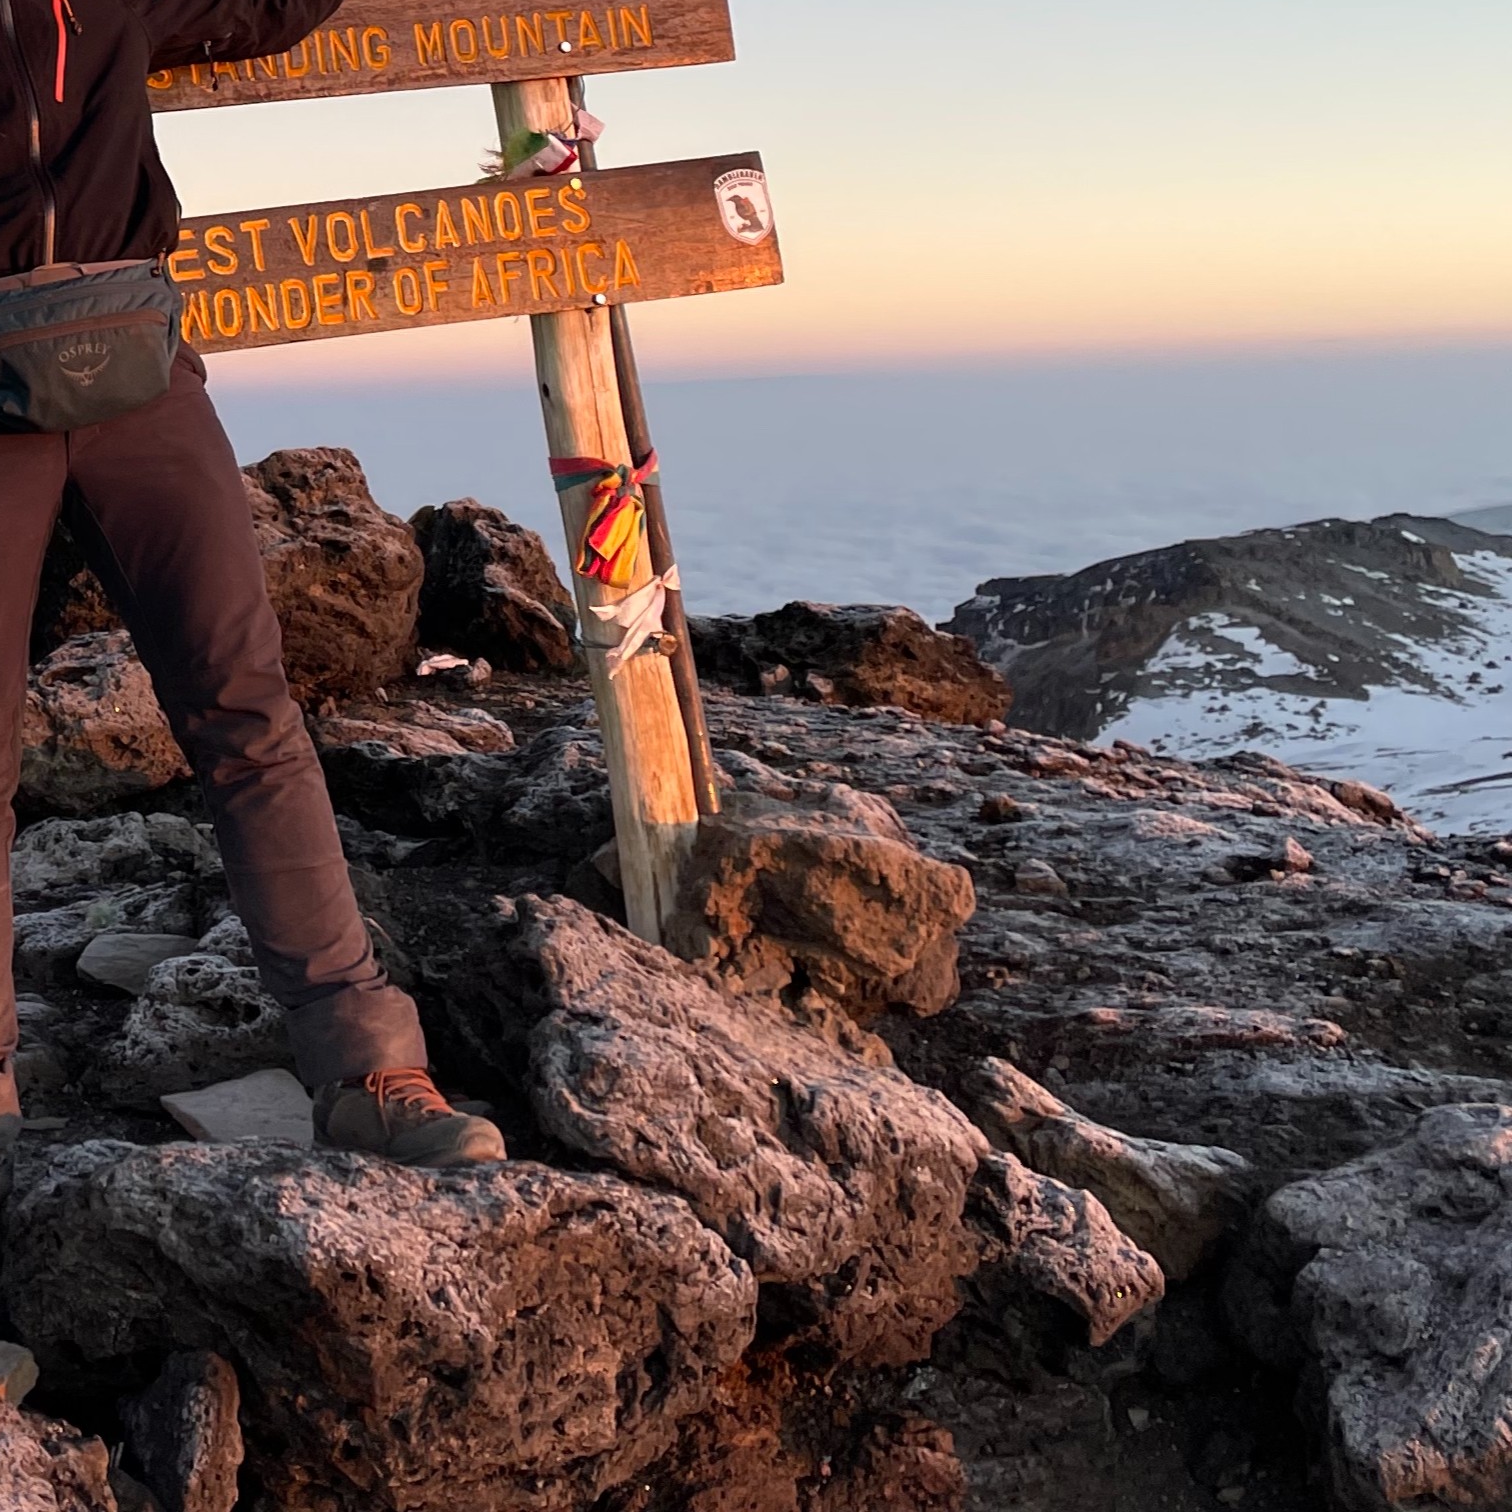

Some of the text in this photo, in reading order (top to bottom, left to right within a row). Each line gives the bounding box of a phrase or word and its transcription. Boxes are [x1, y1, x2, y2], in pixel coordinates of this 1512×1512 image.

[413, 3, 655, 67] MOUNTAIN
[288, 185, 592, 267] VOLCANOES
[180, 269, 380, 344] WONDER
[393, 259, 451, 317] OF
[471, 238, 642, 310] AFRICA
[58, 342, 112, 364] OSPREY
